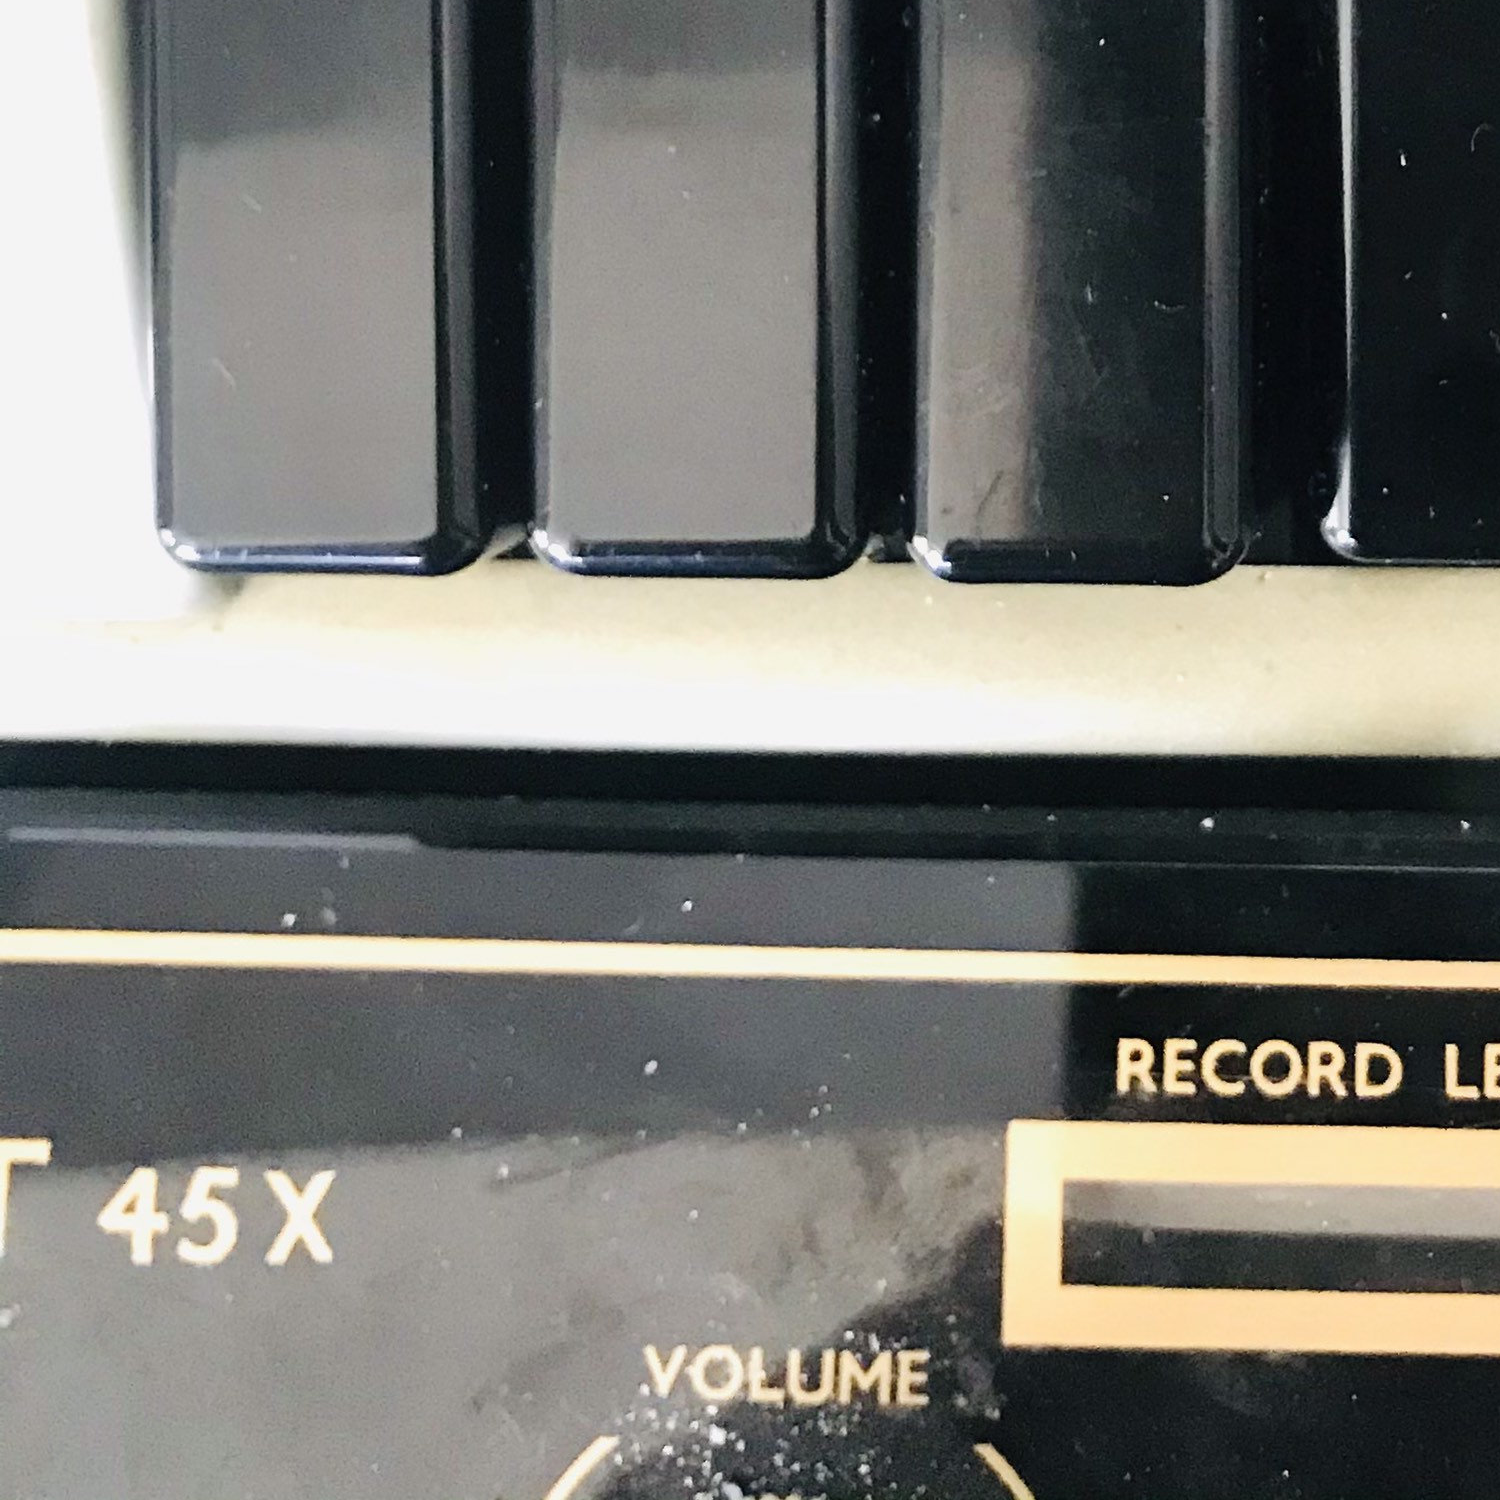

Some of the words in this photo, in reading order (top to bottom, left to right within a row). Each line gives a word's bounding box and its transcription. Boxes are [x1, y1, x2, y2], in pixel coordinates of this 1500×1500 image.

[1114, 1036, 1404, 1100] RECORD
[96, 1165, 241, 1267] 45
[262, 1168, 338, 1267] X
[642, 1342, 932, 1407] VOLUME
